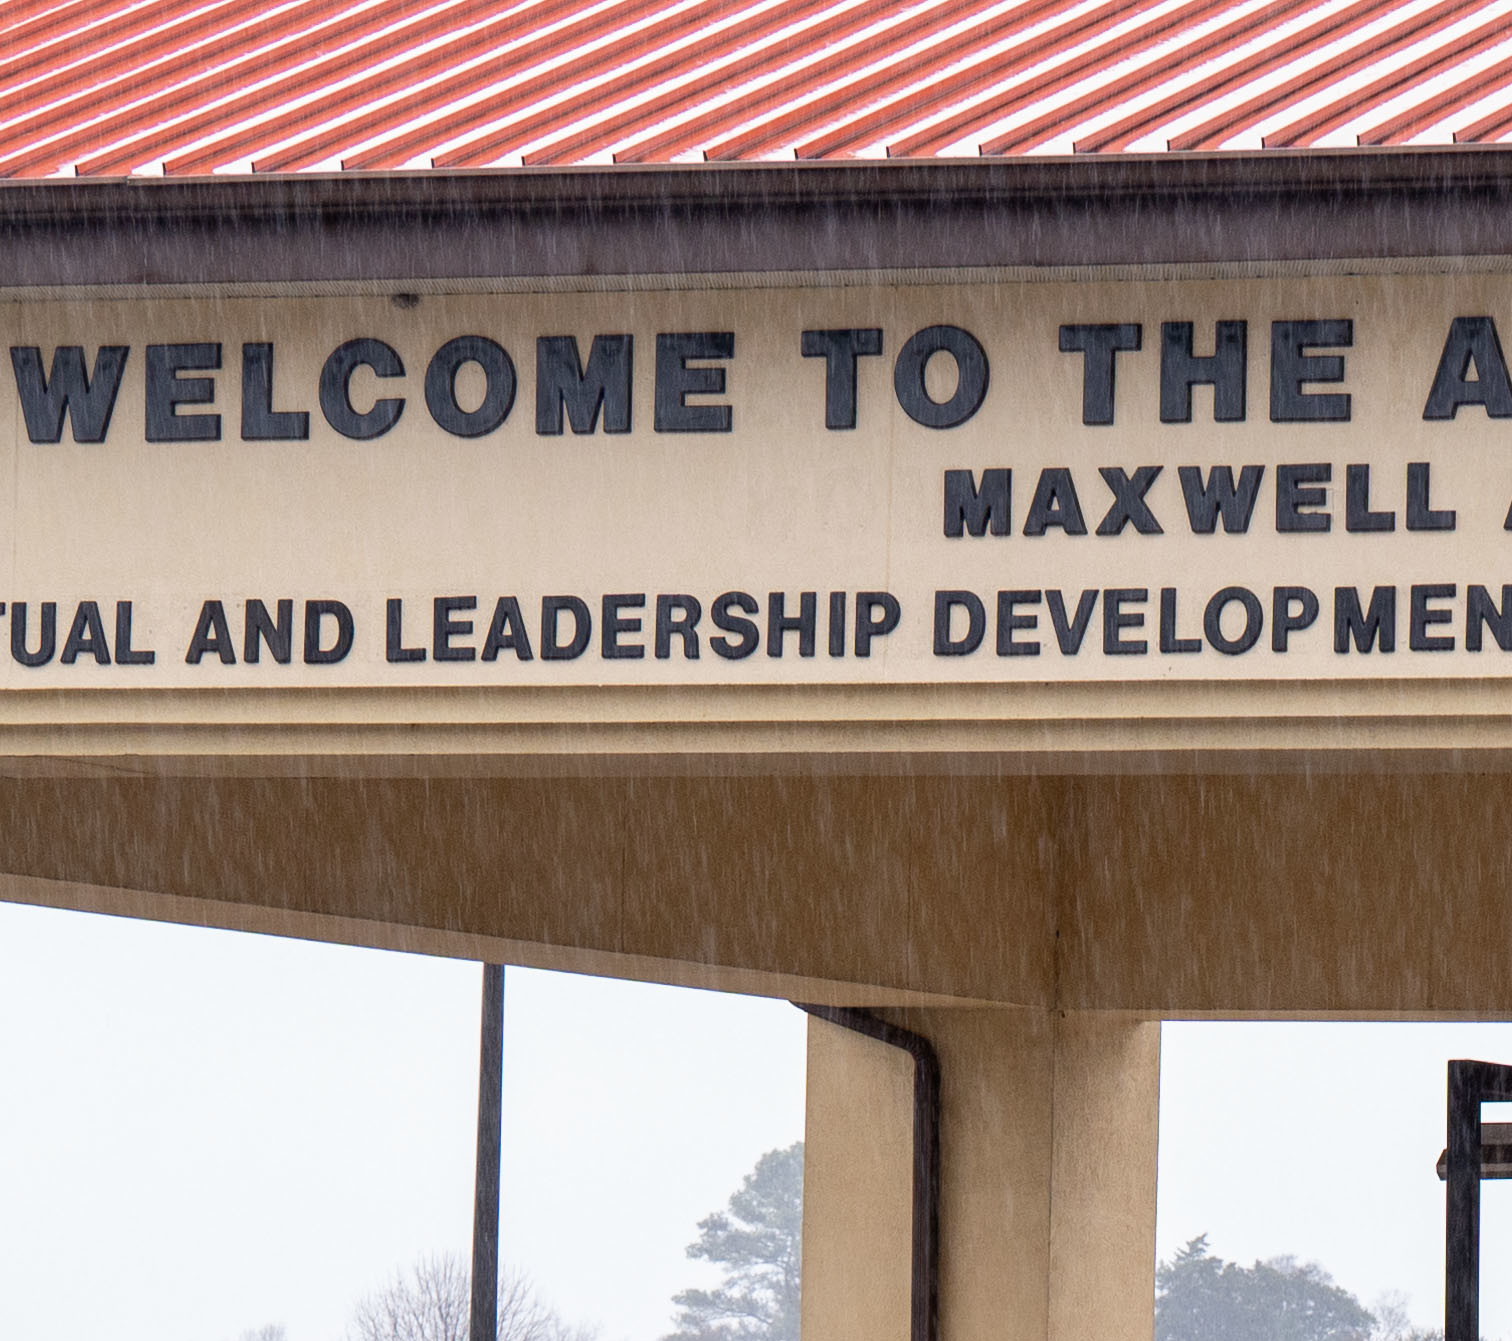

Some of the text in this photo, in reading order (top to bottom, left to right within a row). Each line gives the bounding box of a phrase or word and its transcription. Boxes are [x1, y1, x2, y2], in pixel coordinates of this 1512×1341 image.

[9, 328, 737, 445] WELCOME
[801, 322, 991, 431] TO
[1058, 314, 1355, 427] THE
[943, 462, 1458, 539] MAXWELL
[185, 598, 355, 666] AND
[386, 591, 901, 664] LEADERSHIP
